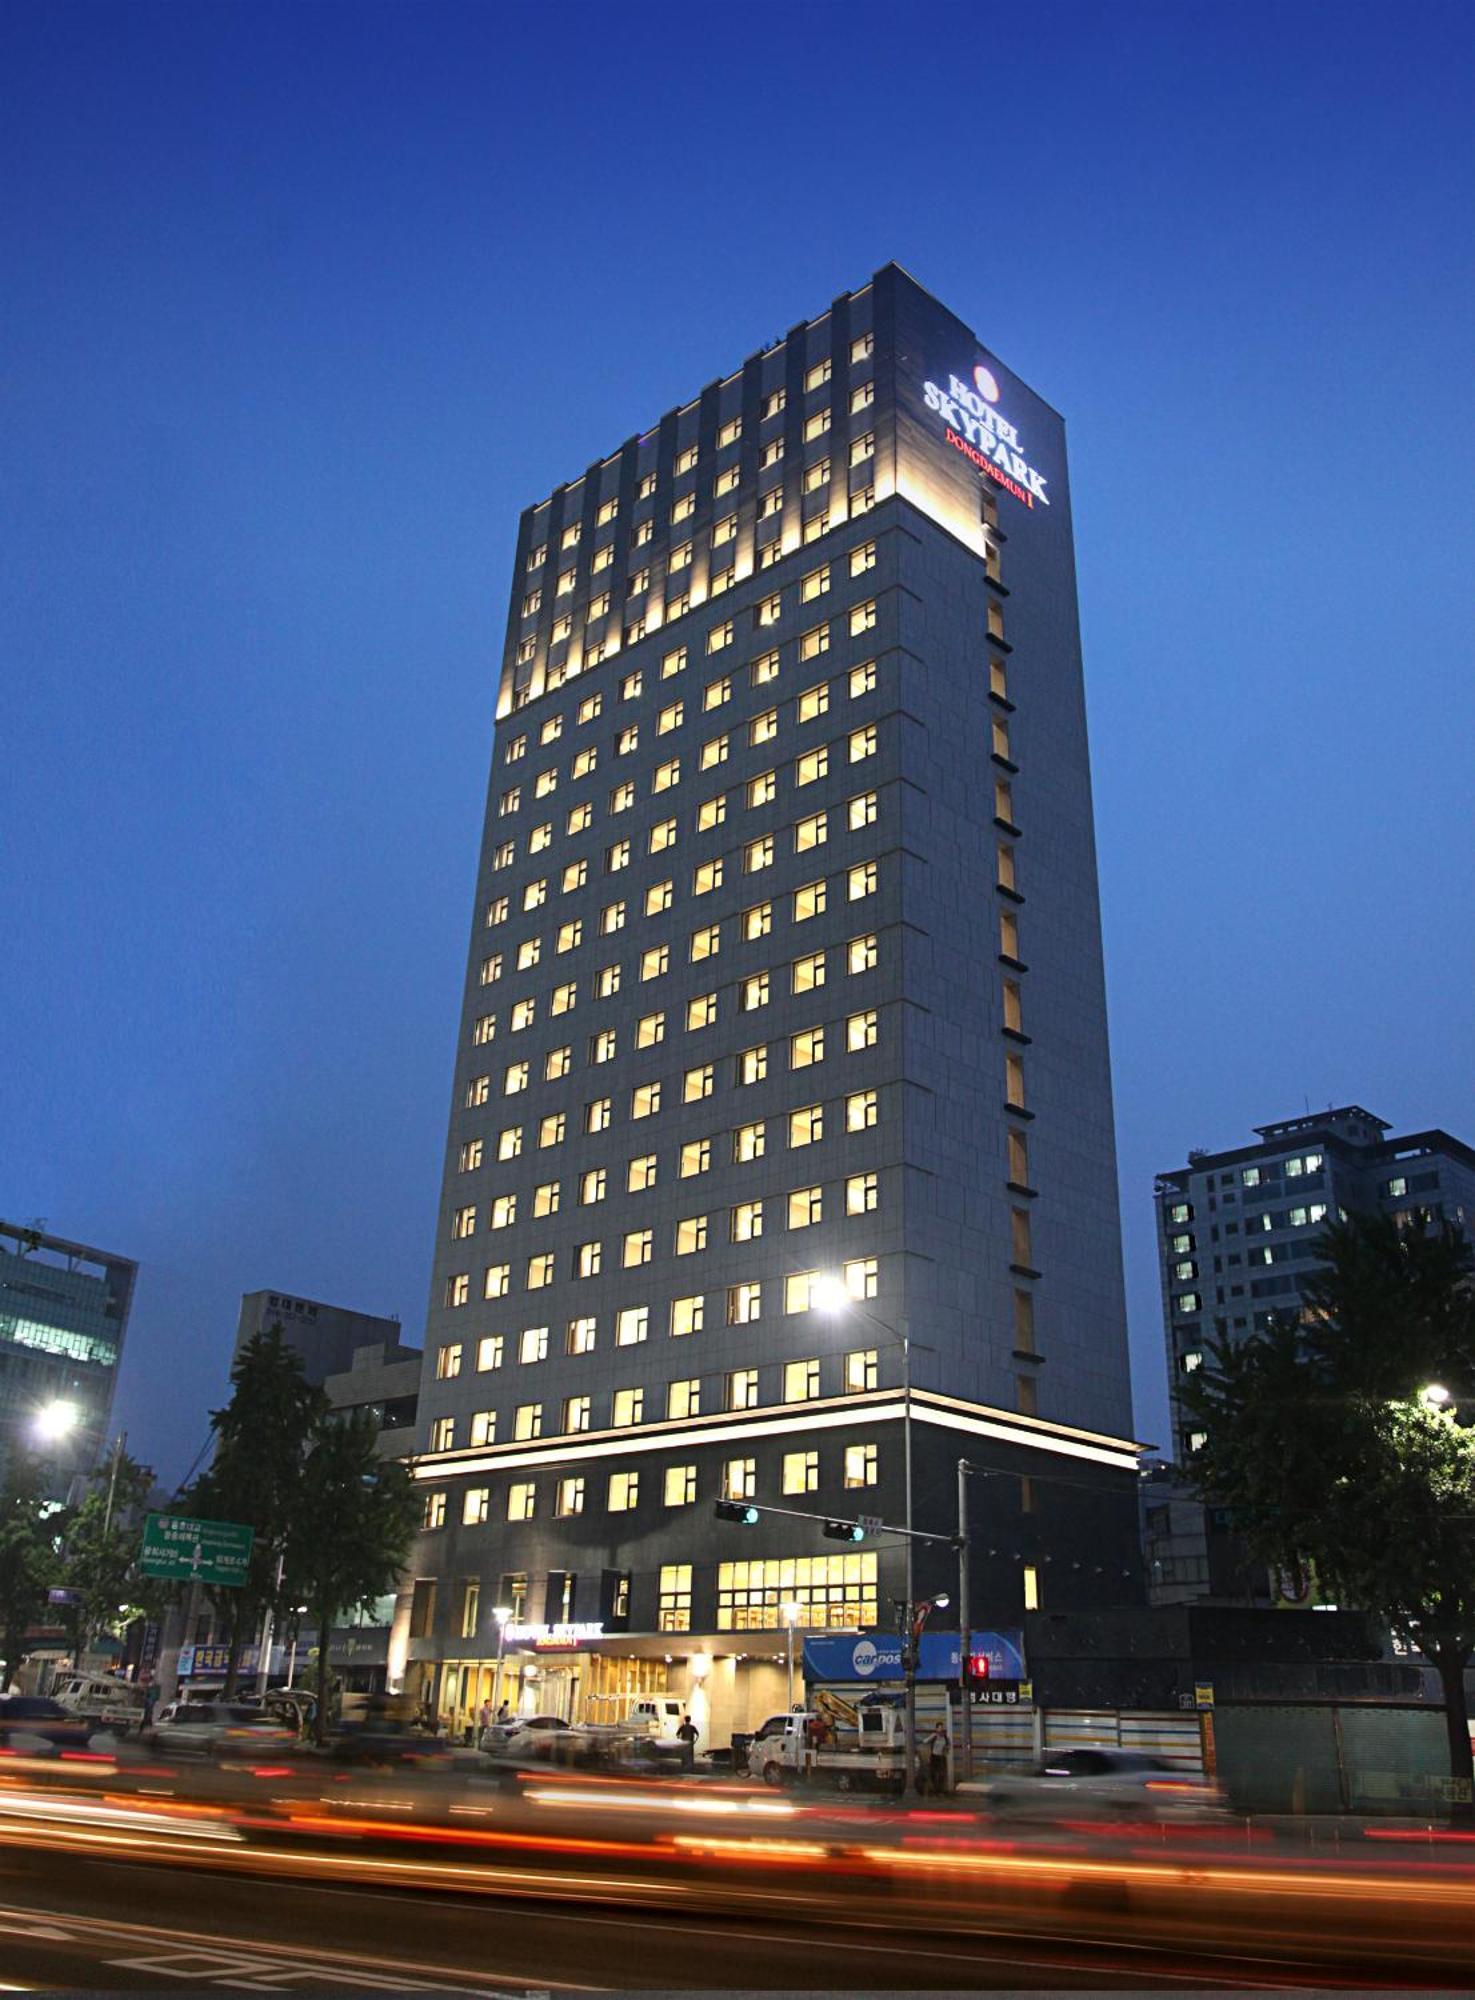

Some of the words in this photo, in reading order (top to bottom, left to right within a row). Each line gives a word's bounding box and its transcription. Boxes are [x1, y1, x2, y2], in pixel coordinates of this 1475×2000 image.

[923, 381, 1050, 505] SKYPARK
[949, 374, 1024, 454] HOTEL
[945, 427, 1026, 503] DONGDAEMUN
